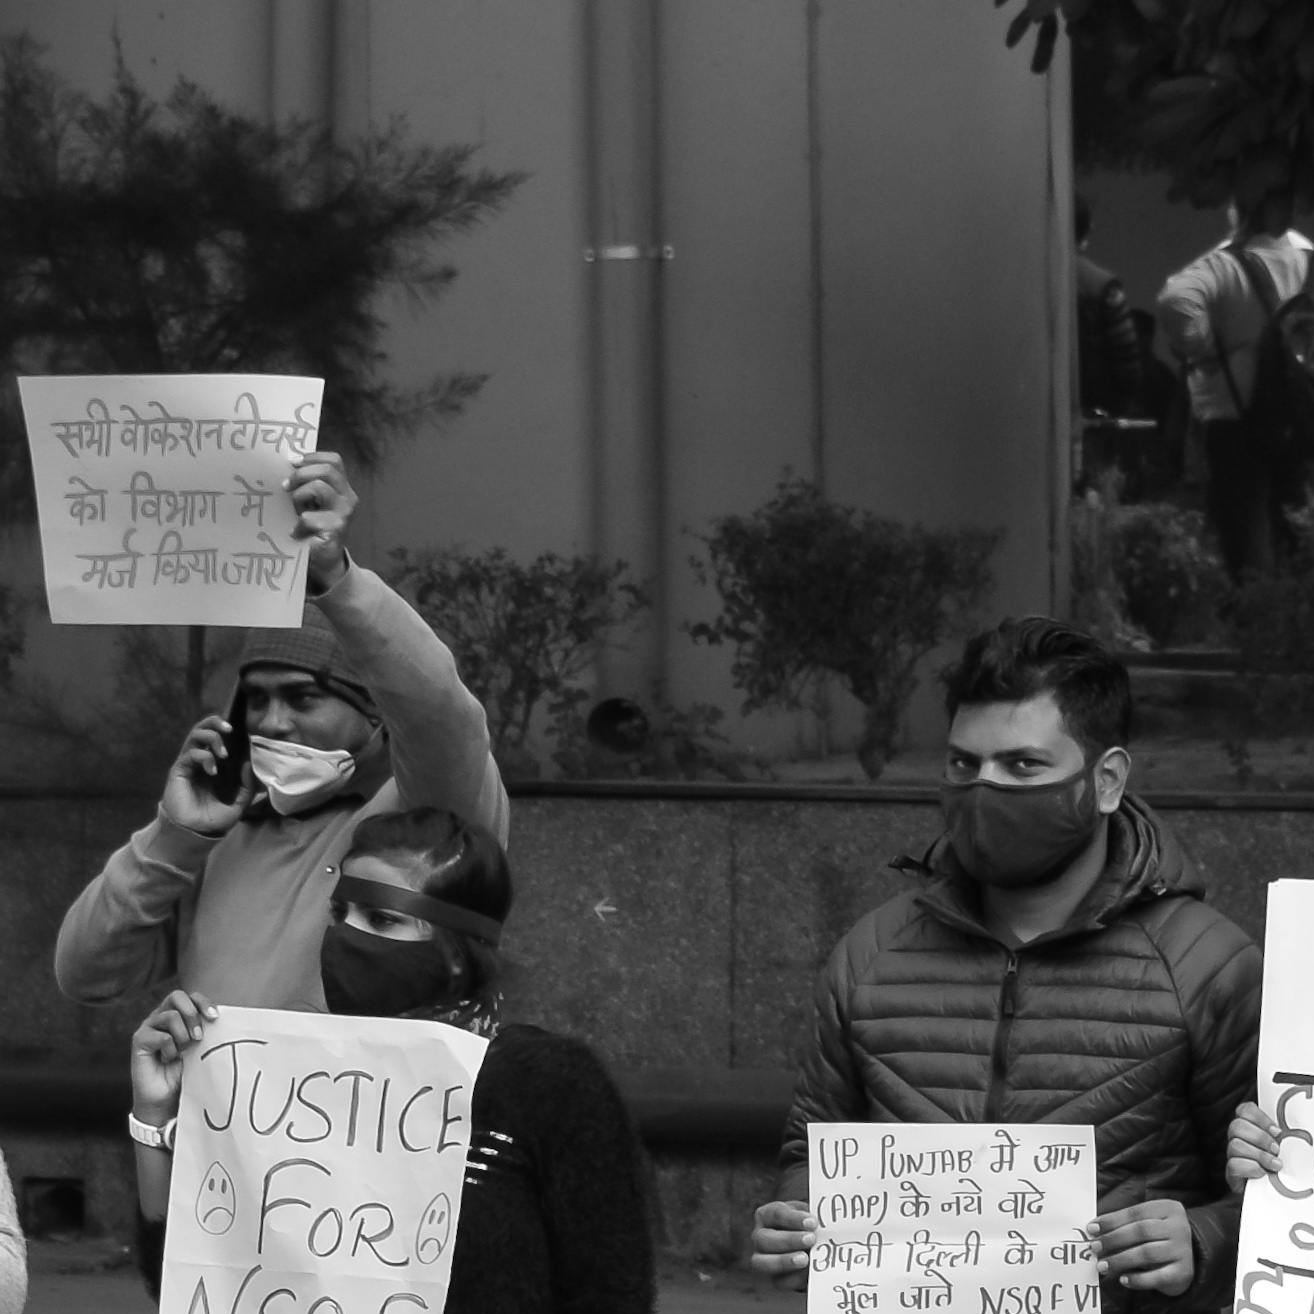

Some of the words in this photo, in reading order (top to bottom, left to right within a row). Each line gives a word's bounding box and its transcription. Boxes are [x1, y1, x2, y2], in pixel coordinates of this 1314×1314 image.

[50, 398, 119, 458] सभी
[64, 476, 108, 526] को
[121, 471, 225, 527] विभाग
[234, 474, 273, 527] में
[152, 530, 219, 585] किया
[200, 1038, 467, 1154] JUSTICE
[880, 1134, 973, 1180] PUNJAB
[990, 1129, 1022, 1173] में
[1033, 1143, 1086, 1173] आप
[257, 1157, 410, 1267] FOR
[816, 1191, 889, 1228] (AAP)
[899, 1181, 931, 1218] के
[940, 1178, 983, 1216] नये
[998, 1179, 1046, 1219] वादे
[906, 1229, 986, 1272] दिल्ली
[1004, 1230, 1038, 1265] के
[899, 1269, 953, 1310] जाते
